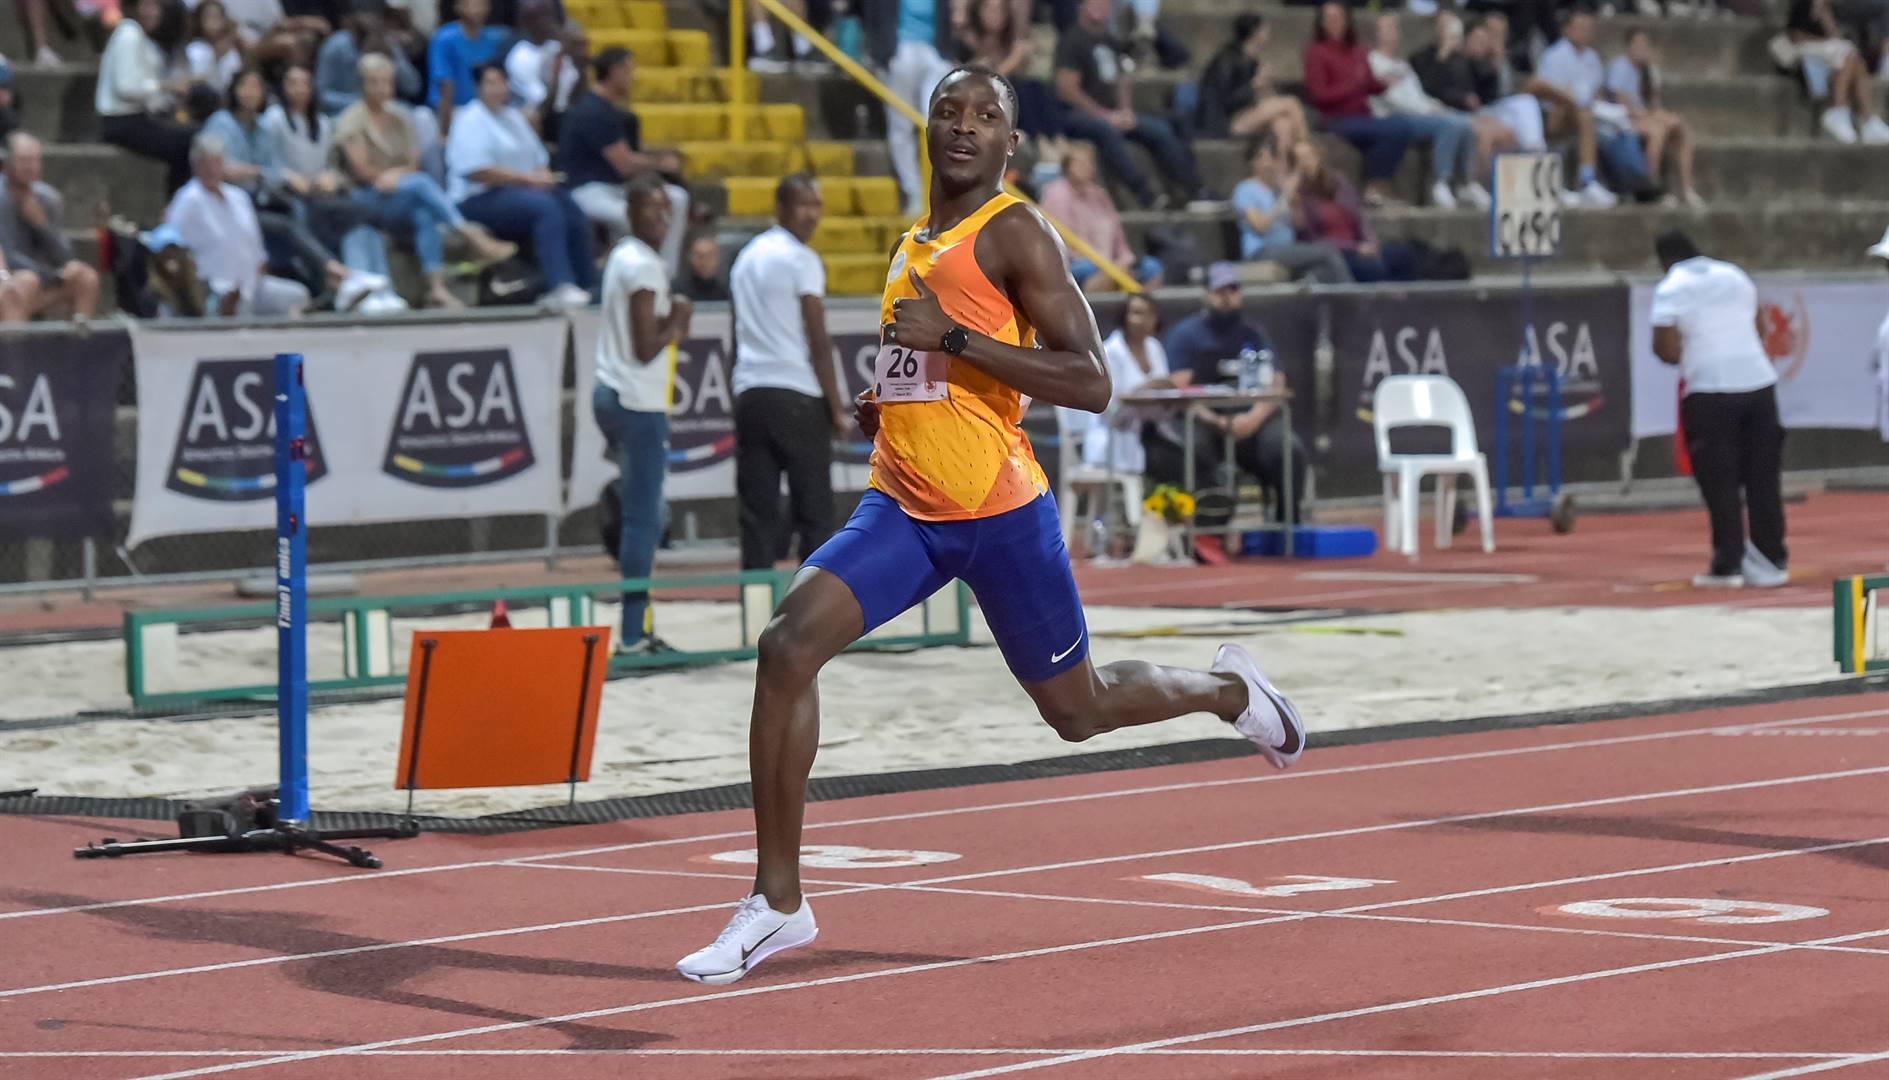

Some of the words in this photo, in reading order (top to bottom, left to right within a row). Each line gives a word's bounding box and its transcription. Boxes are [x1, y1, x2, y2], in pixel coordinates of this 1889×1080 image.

[671, 350, 730, 416] SA
[886, 348, 918, 378] 26
[1363, 326, 1449, 385] ASA
[186, 371, 276, 443] AS
[402, 360, 516, 430] ASA
